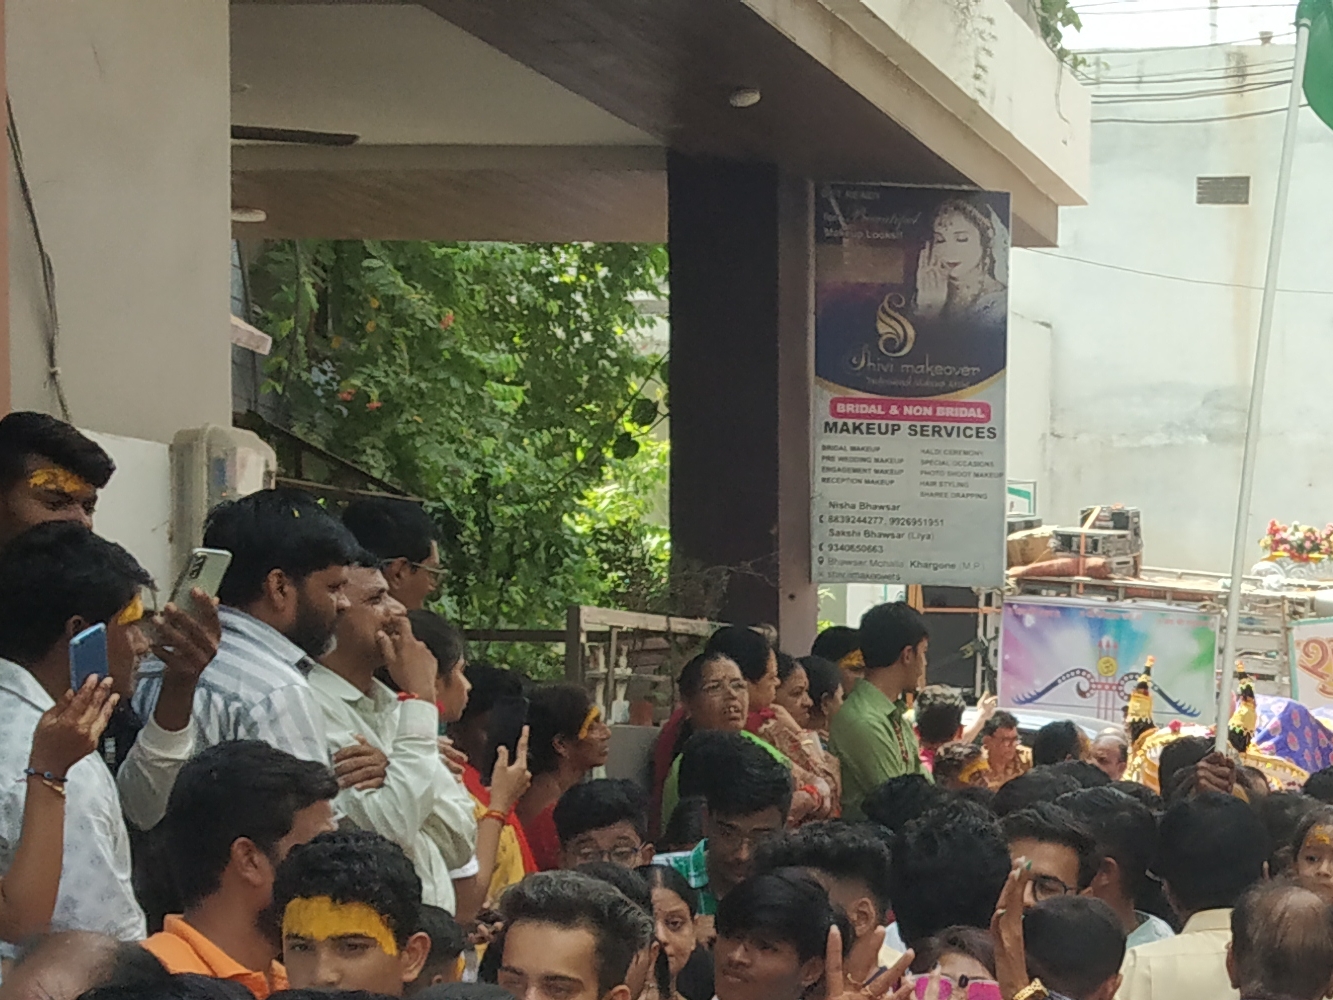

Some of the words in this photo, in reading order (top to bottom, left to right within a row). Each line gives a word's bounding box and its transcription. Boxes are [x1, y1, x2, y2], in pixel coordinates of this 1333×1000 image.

[901, 353, 981, 377] makeover
[836, 402, 886, 415] BRIDAL
[888, 405, 900, 416] &
[903, 406, 933, 417] NON
[936, 406, 985, 419] BRIDAL
[823, 420, 902, 436] MAKEUP
[907, 424, 998, 439] SERVICES
[821, 444, 847, 452] BRIDAL
[850, 445, 881, 453] MAKEUP
[821, 466, 872, 474] ENGAGEMENT
[864, 478, 895, 486] MAKEUP
[828, 501, 856, 510] Nisha
[859, 502, 901, 511] Bhawsar
[828, 528, 861, 537] Sakshi
[863, 529, 905, 539] Bhawsar
[909, 559, 957, 571] Khargone
